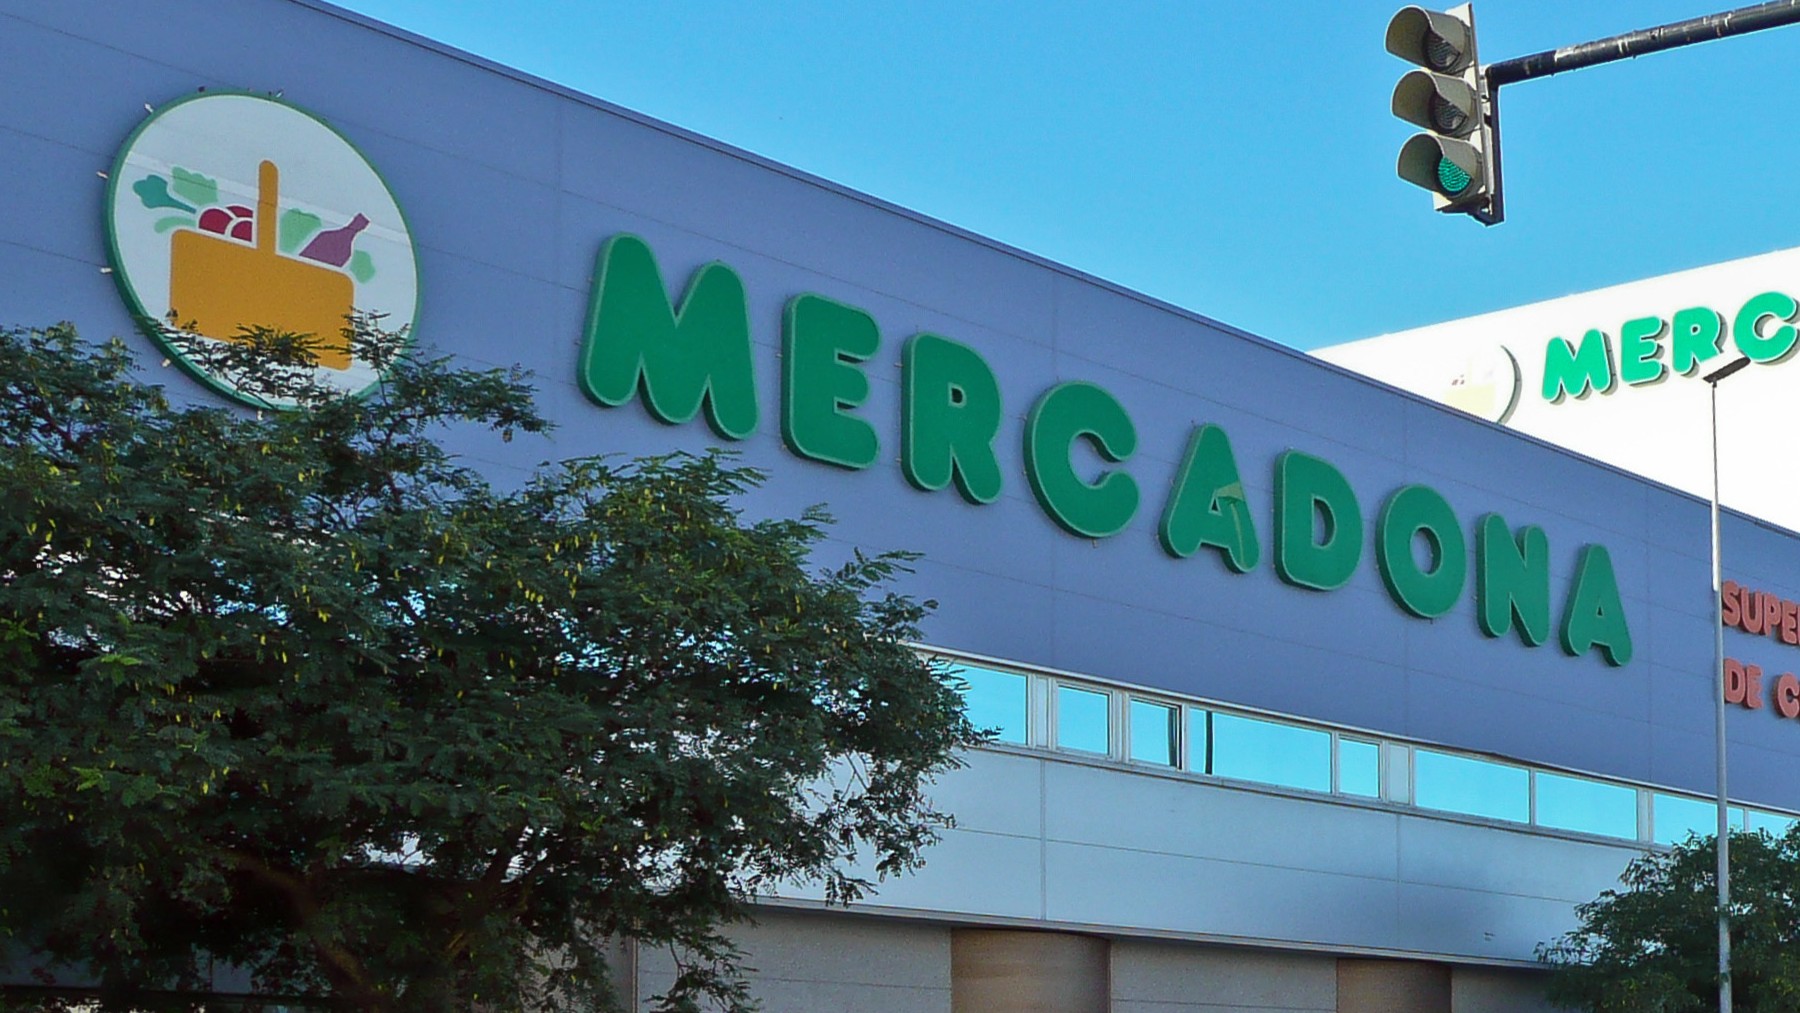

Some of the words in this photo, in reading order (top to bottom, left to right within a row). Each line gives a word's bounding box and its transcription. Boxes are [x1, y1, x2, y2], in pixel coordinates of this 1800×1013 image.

[1541, 290, 1799, 402] MERC
[577, 232, 1633, 666] MERCADONA
[1722, 580, 1800, 645] SUPE
[1723, 656, 1764, 709] DE
